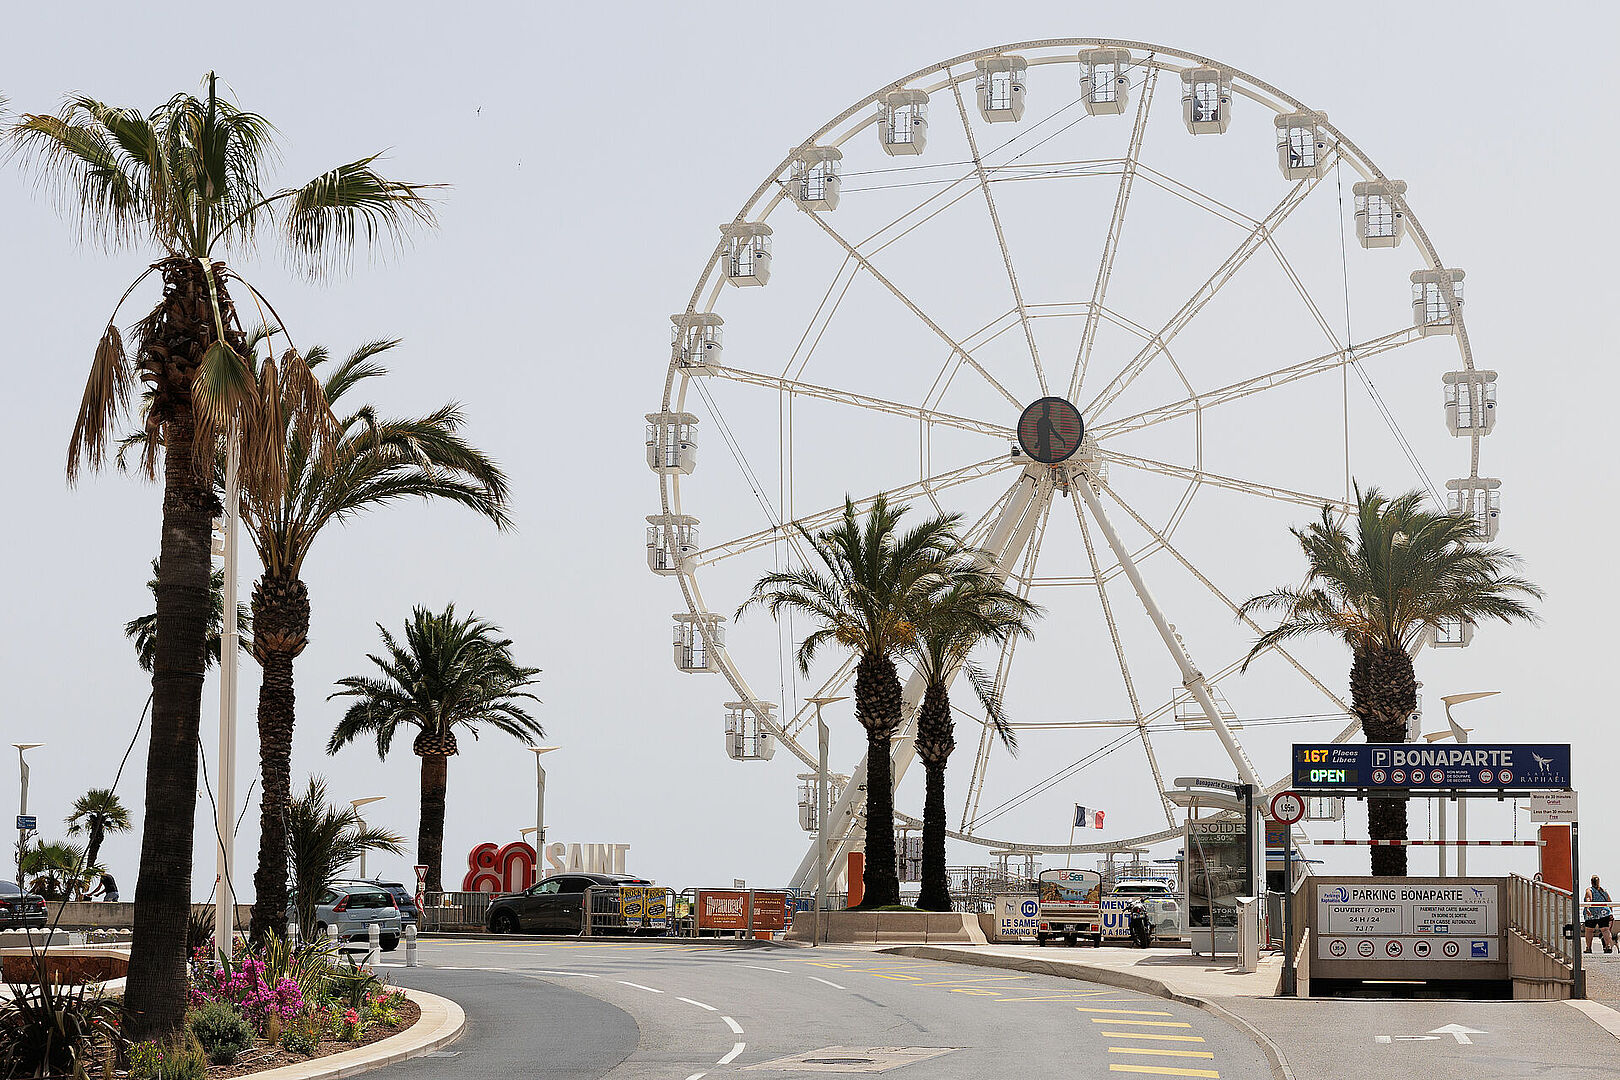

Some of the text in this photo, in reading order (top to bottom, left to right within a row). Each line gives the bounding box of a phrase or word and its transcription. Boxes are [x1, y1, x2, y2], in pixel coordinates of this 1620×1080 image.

[1303, 749, 1329, 763] 167
[1393, 750, 1513, 766] BONAPARTE
[1309, 769, 1346, 783] OPEN
[545, 842, 631, 875] SAINT
[1352, 889, 1397, 901] PARKING
[1401, 889, 1463, 901] BONAPARTE
[1023, 904, 1036, 914] ICI
[1001, 918, 1012, 927] LE
[1001, 928, 1031, 936] PARKING
[1446, 945, 1456, 953] 10
